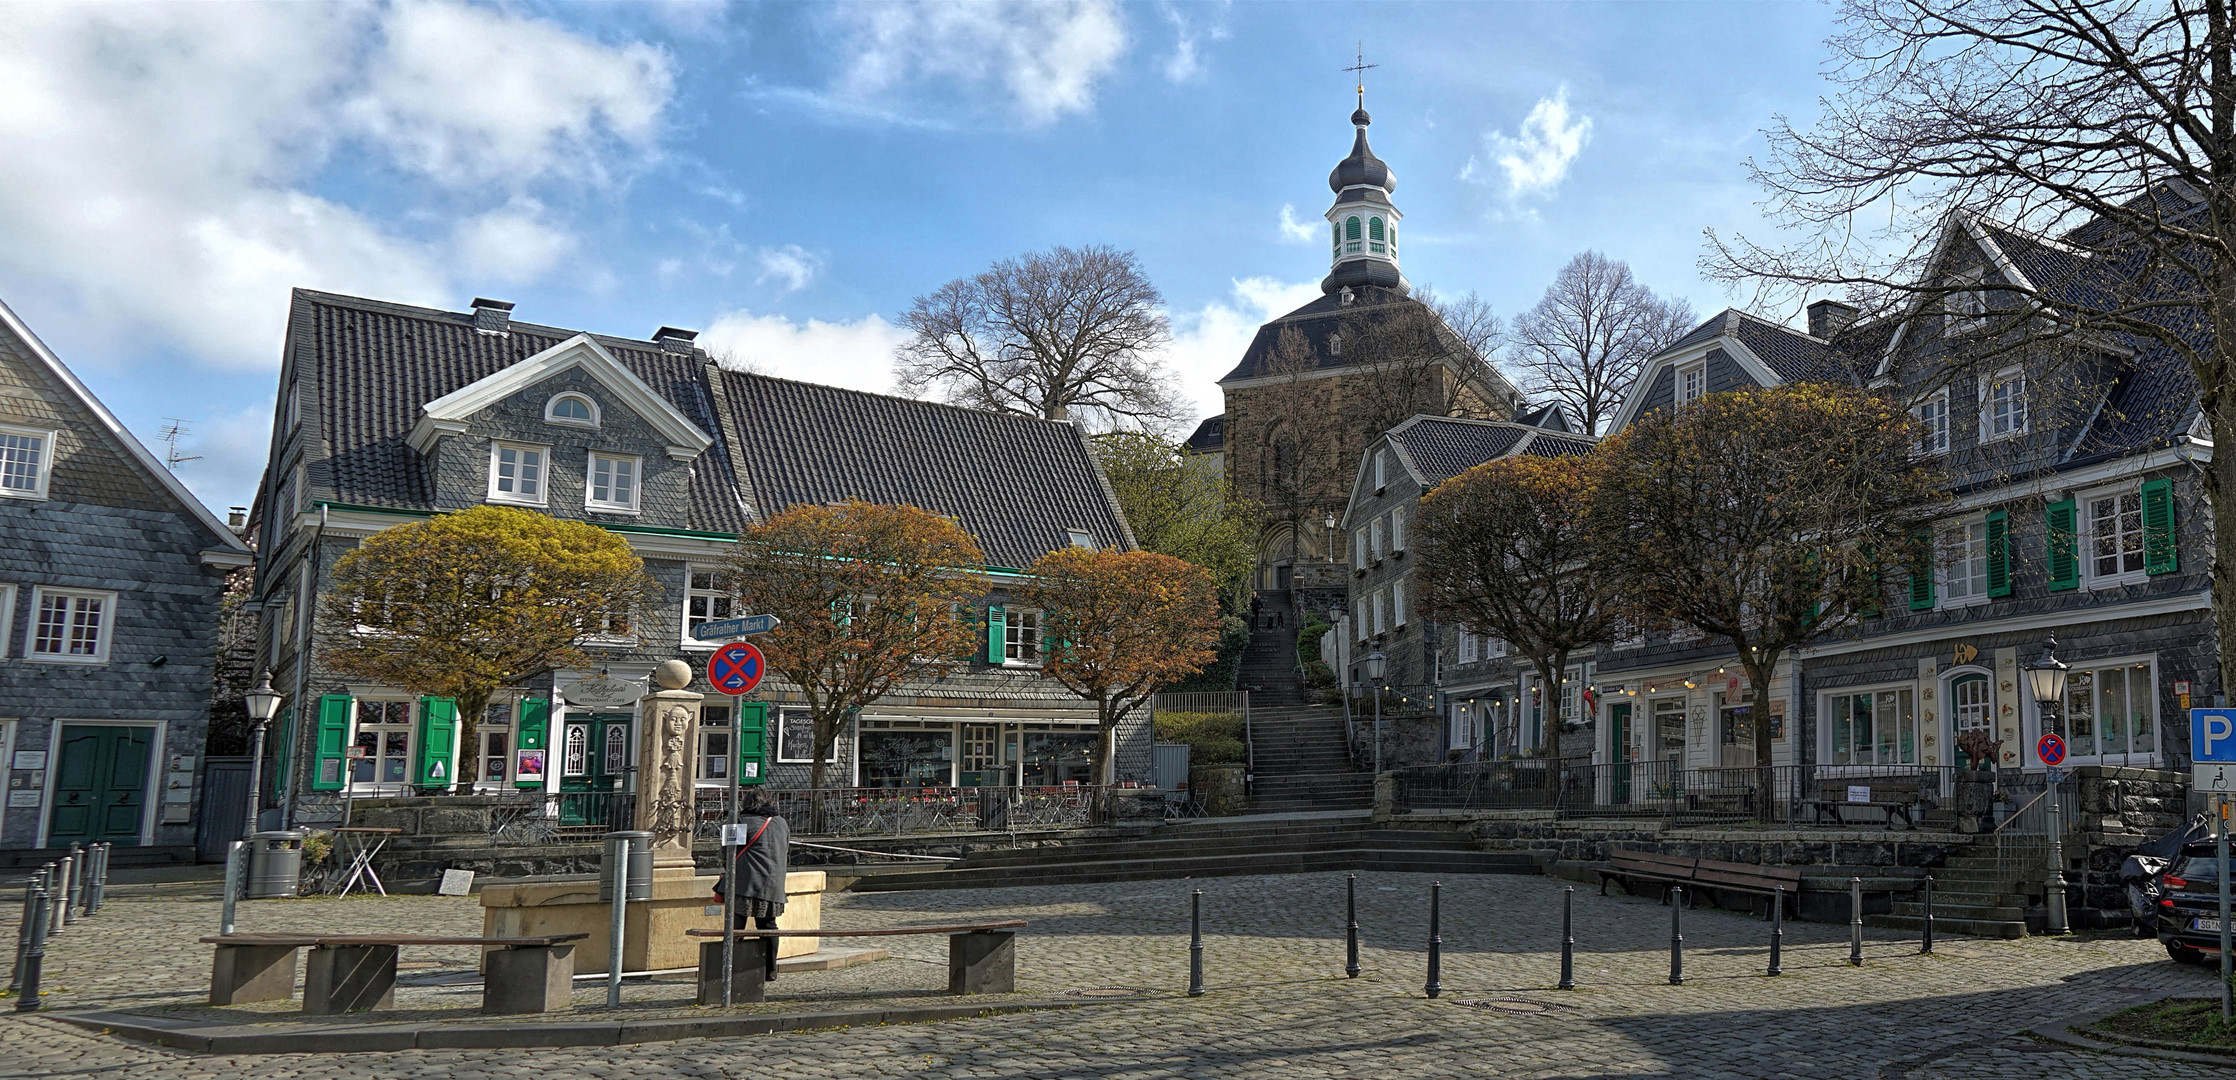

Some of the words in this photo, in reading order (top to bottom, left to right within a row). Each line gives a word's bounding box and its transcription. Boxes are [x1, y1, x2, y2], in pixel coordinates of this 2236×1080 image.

[701, 623, 740, 637] Gräfrather
[742, 618, 764, 632] Markt
[2203, 715, 2233, 756] P
[2200, 920, 2210, 929] SG
